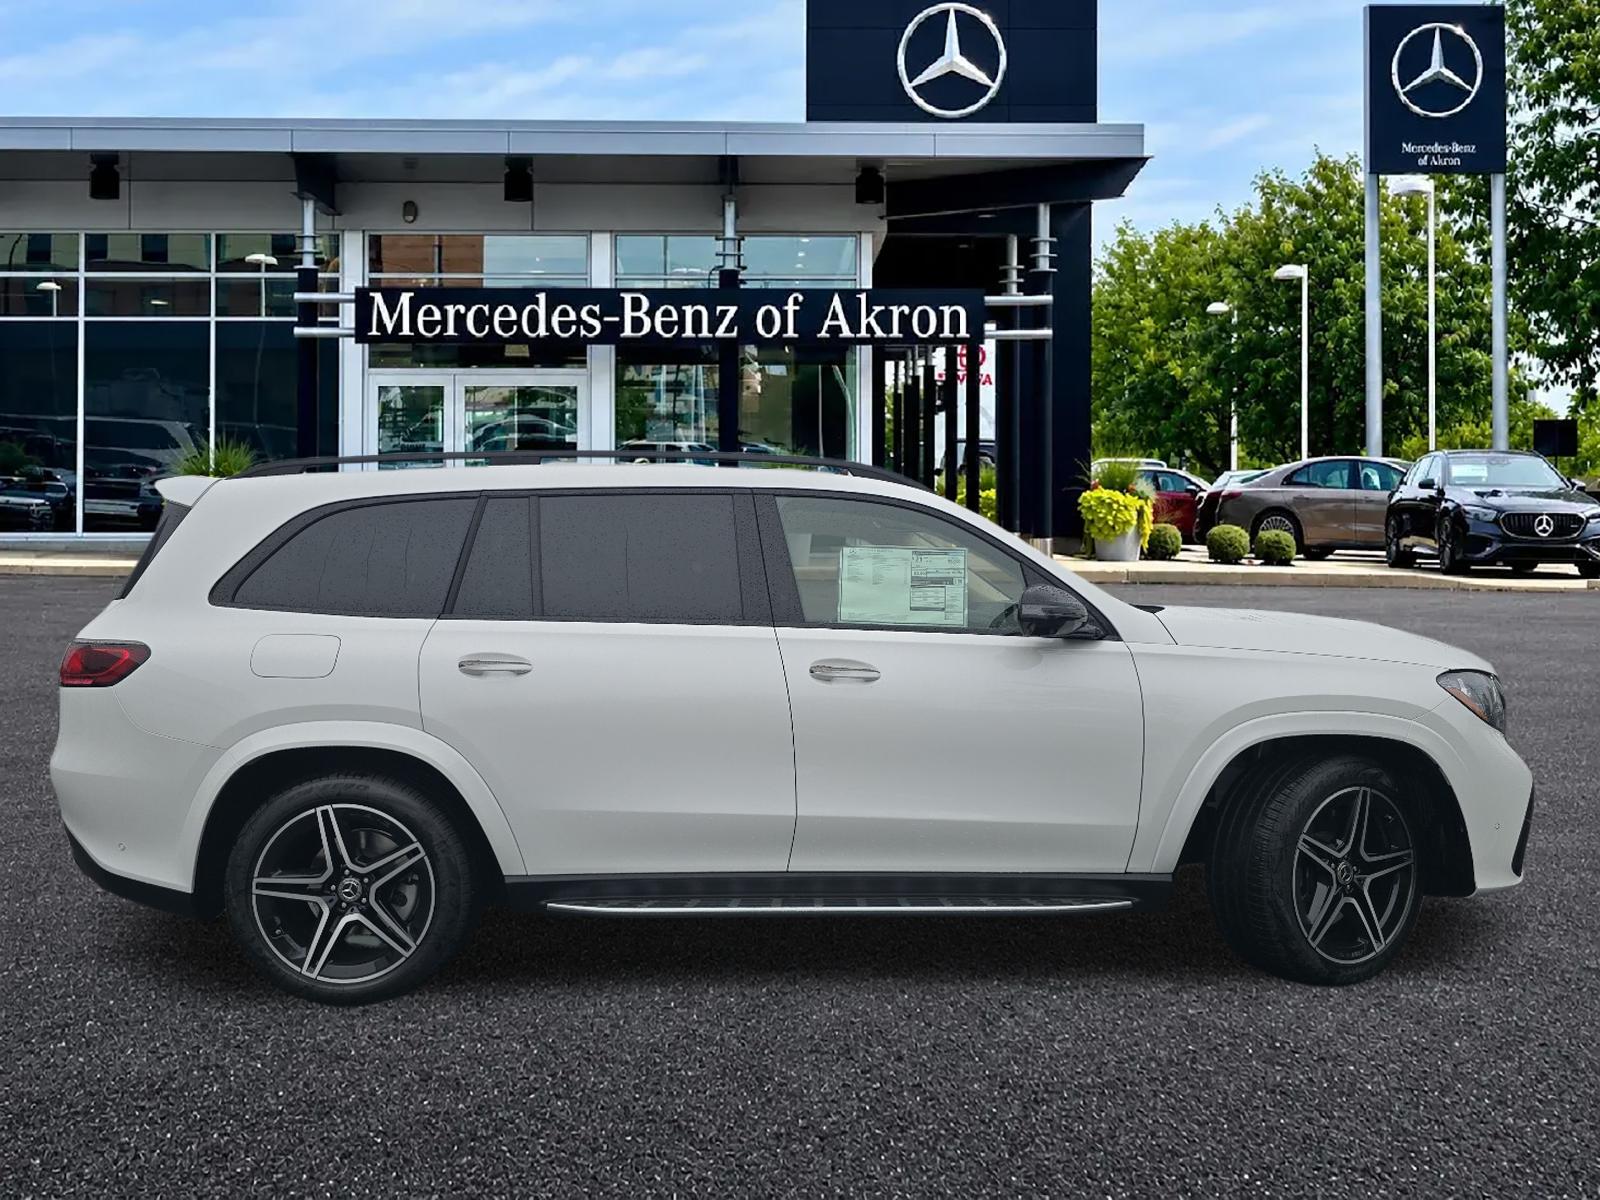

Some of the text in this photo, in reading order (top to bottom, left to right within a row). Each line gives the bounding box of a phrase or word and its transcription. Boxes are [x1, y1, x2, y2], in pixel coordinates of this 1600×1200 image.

[1401, 141, 1477, 153] Mercedes-Benz
[1417, 154, 1461, 166] of Akron
[367, 291, 971, 338] Mercedes-Benz of Akron
